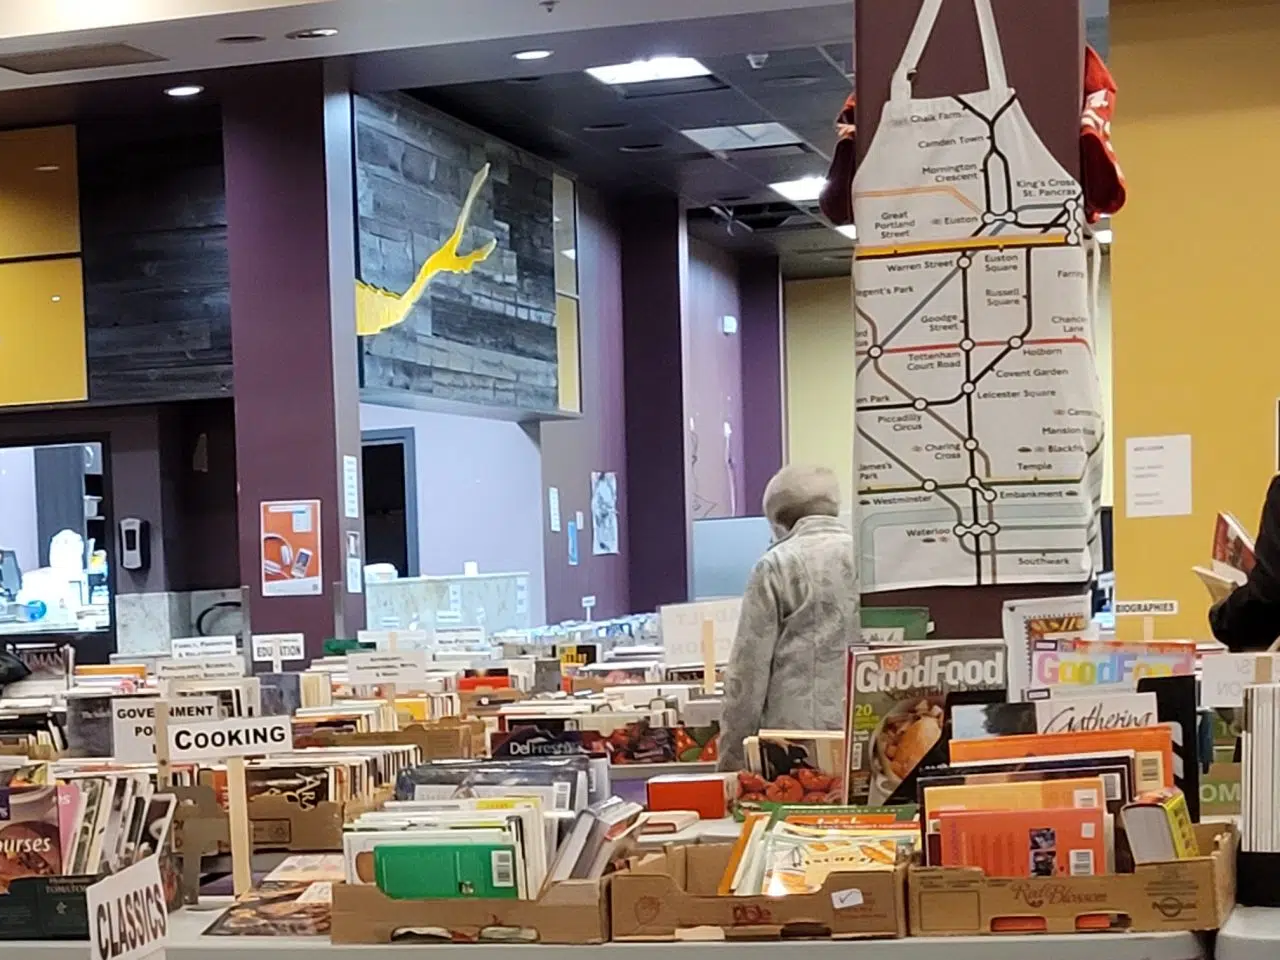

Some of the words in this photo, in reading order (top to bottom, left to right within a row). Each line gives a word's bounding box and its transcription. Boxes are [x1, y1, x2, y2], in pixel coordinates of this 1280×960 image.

[918, 138, 956, 149] Camden
[960, 135, 984, 145] Town
[922, 163, 977, 175] Mornington
[935, 172, 978, 183] Crescent
[1049, 178, 1075, 187] Cross
[1039, 187, 1076, 196] Pancras
[881, 211, 908, 220] Great
[944, 214, 978, 225] Euston
[875, 220, 915, 230] Portland
[881, 229, 910, 239] Street
[984, 253, 1018, 263] Euston
[887, 263, 921, 273] Warren
[924, 259, 953, 269] Street
[985, 263, 1018, 273] Square
[893, 286, 914, 295] Park
[985, 288, 1020, 297] Russell
[987, 297, 1020, 307] Square
[921, 314, 958, 325] Goodge
[929, 322, 958, 331] Street
[1063, 325, 1084, 333] Lane
[908, 351, 960, 362] Tottenham
[1023, 347, 1062, 357] Holborn
[907, 361, 934, 371] Court
[937, 360, 961, 369] Road
[996, 369, 1031, 378] Covent
[1033, 367, 1068, 377] Garden
[977, 389, 1020, 399] Leicester
[1023, 388, 1056, 398] Square
[878, 413, 922, 425] Piccadilly
[893, 423, 922, 432] Circus
[1042, 427, 1080, 436] Mansion
[925, 443, 960, 455] Charing
[934, 451, 961, 460] Cross
[1017, 462, 1052, 472] Temple
[1000, 489, 1063, 498] Embankment
[873, 495, 932, 505] Westminster
[906, 527, 950, 537] Waterloo
[1018, 557, 1070, 566] Southwark
[1116, 603, 1175, 613] BIOGRAPHIES
[22, 651, 65, 667] UMAN
[856, 652, 1004, 693] GoodFood
[117, 705, 214, 719] GOVENMENT
[855, 704, 872, 717] 20
[175, 726, 285, 750] COOKING
